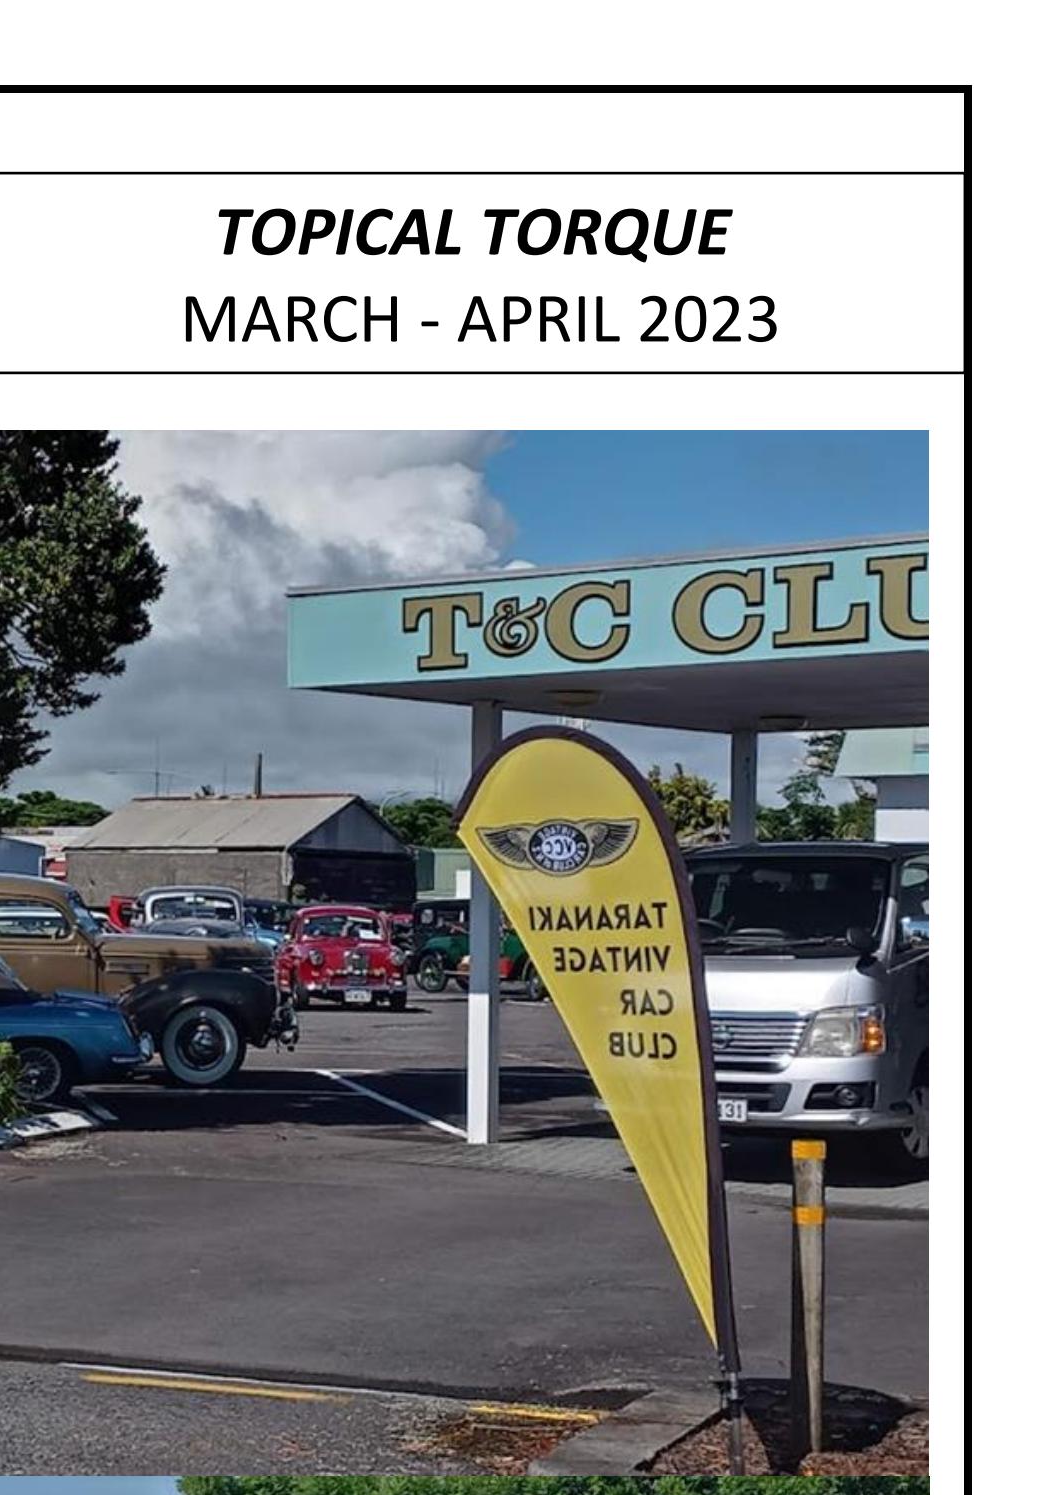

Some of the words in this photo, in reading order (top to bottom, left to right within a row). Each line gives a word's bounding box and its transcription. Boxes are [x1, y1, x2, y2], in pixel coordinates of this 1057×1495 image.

[218, 208, 461, 256] TOPICAL
[483, 208, 734, 263] TORQUE
[185, 295, 398, 343] MARCH
[457, 295, 621, 343] APRIL
[639, 295, 778, 343] 2023
[402, 580, 632, 673] T&C
